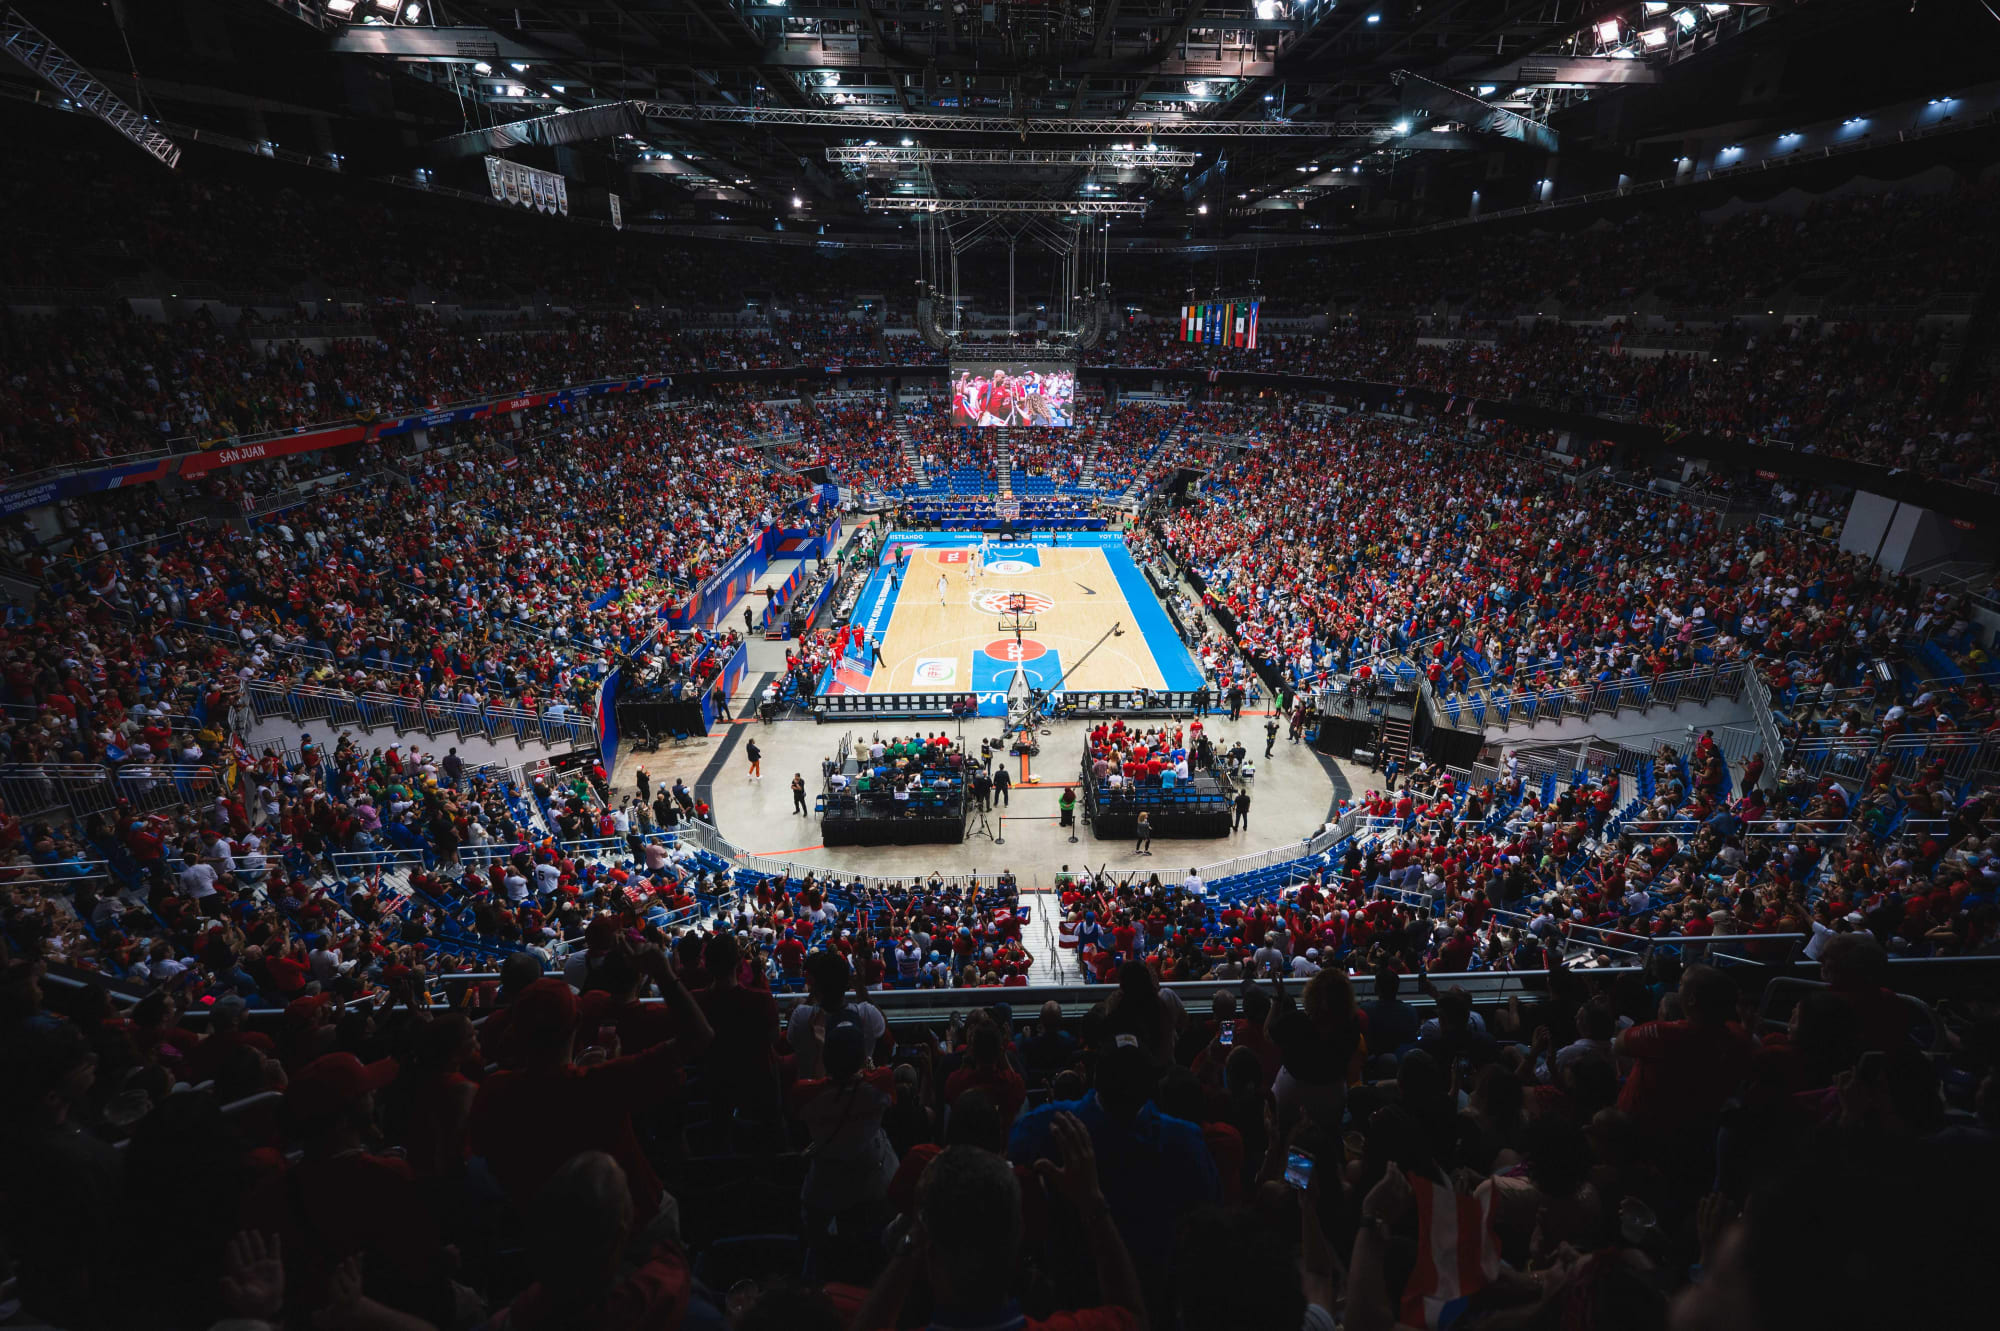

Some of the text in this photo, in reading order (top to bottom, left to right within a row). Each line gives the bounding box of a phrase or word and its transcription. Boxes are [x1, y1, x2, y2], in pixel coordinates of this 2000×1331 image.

[219, 445, 265, 464] SAN JUAN
[538, 871, 545, 881] 5
